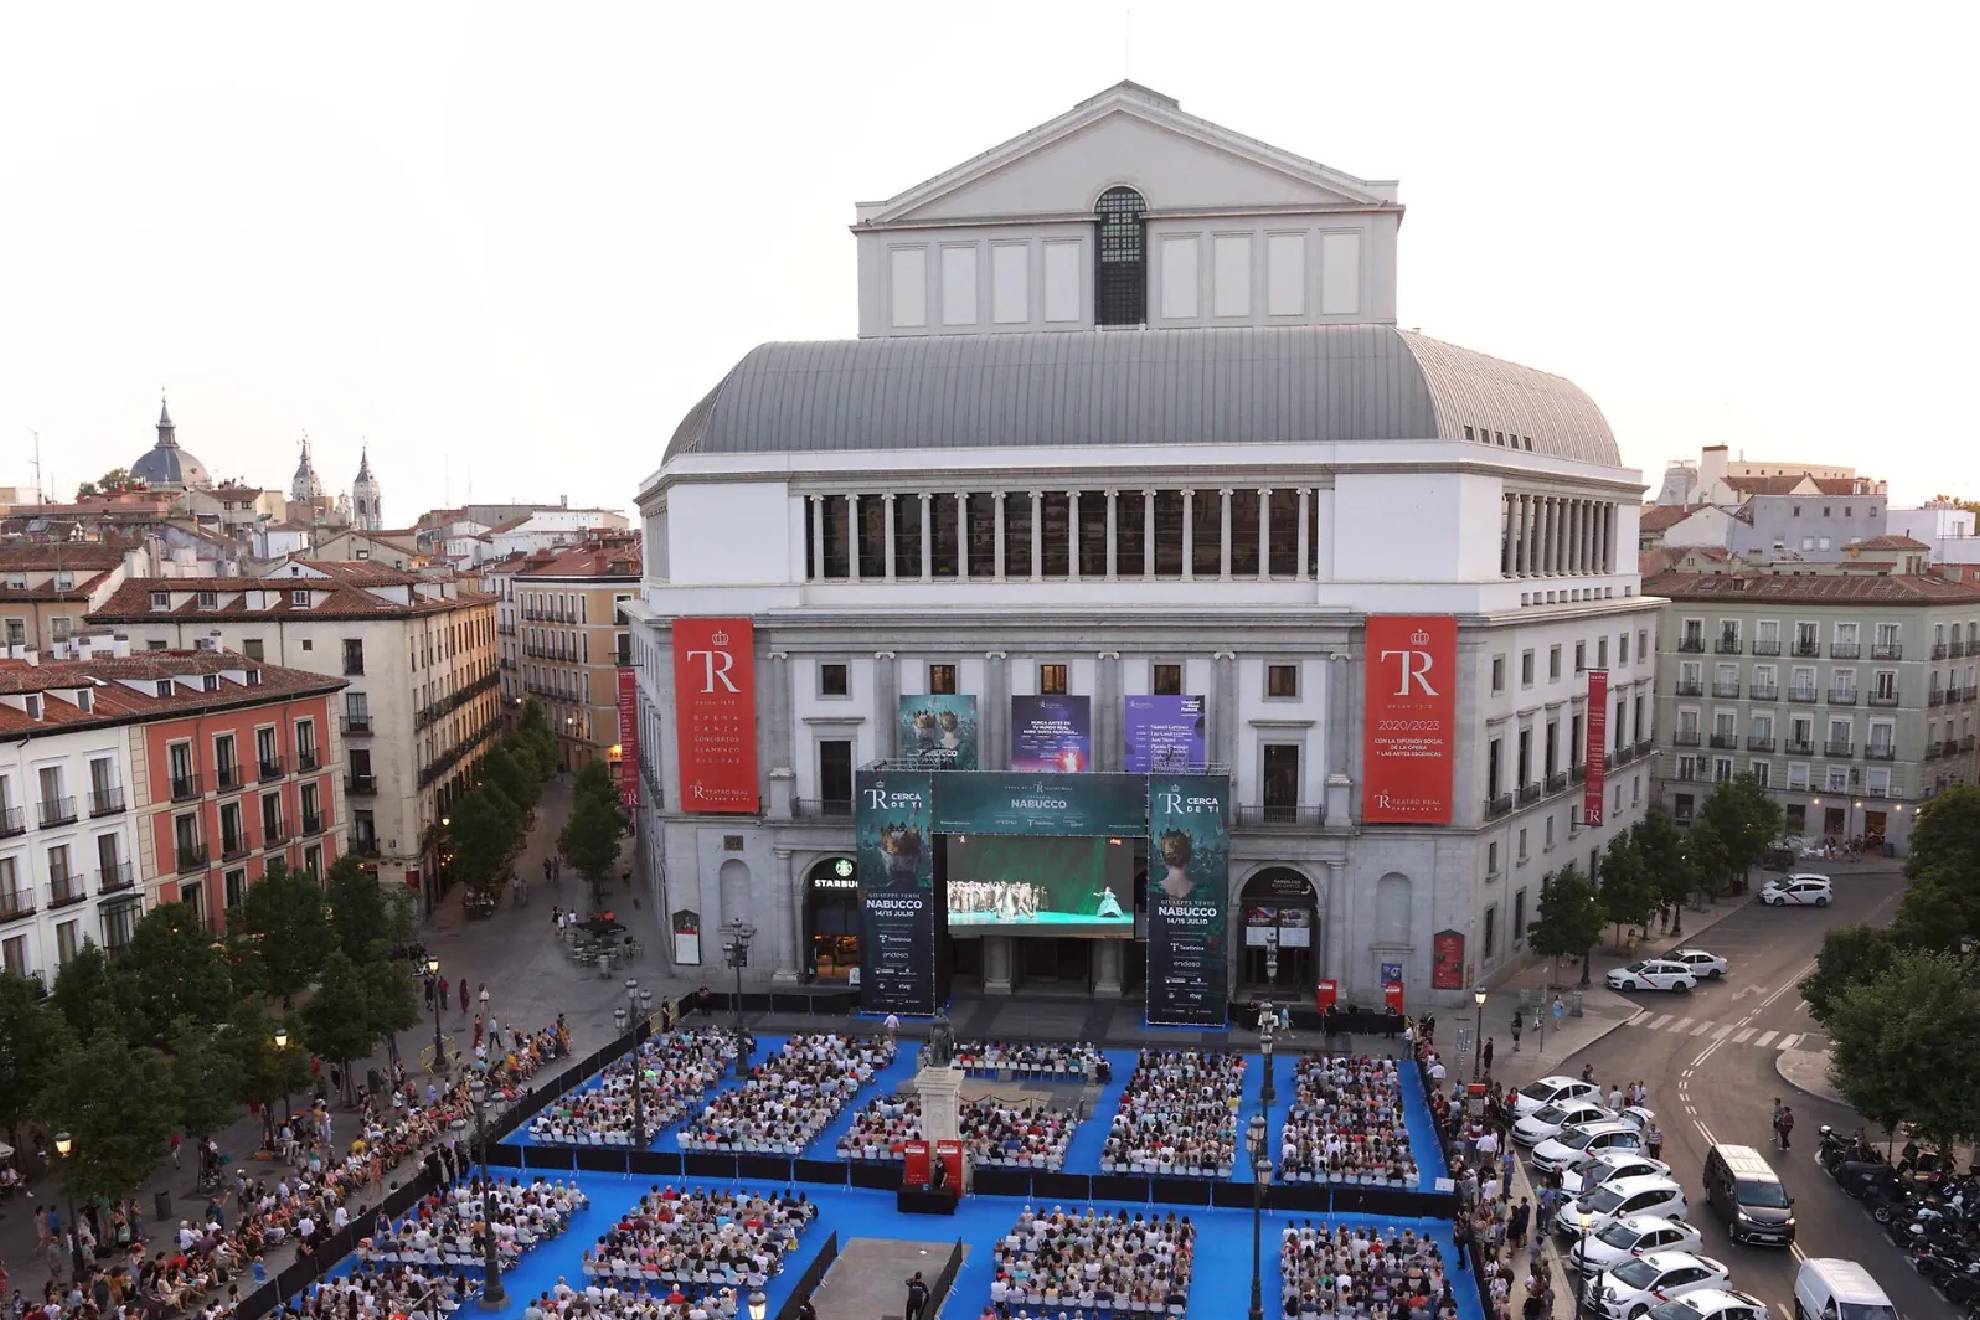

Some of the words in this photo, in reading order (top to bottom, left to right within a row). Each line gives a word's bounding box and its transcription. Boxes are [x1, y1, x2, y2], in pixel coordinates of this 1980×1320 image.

[687, 651, 742, 693] TR
[1381, 651, 1440, 696] TR
[891, 793, 922, 801] CERCA
[1186, 797, 1219, 805] CERCA
[1010, 799, 1068, 809] NABUCCO
[1186, 805, 1202, 813] DE
[866, 899, 923, 909] NABUCCO
[1158, 906, 1218, 917] NABUCCO
